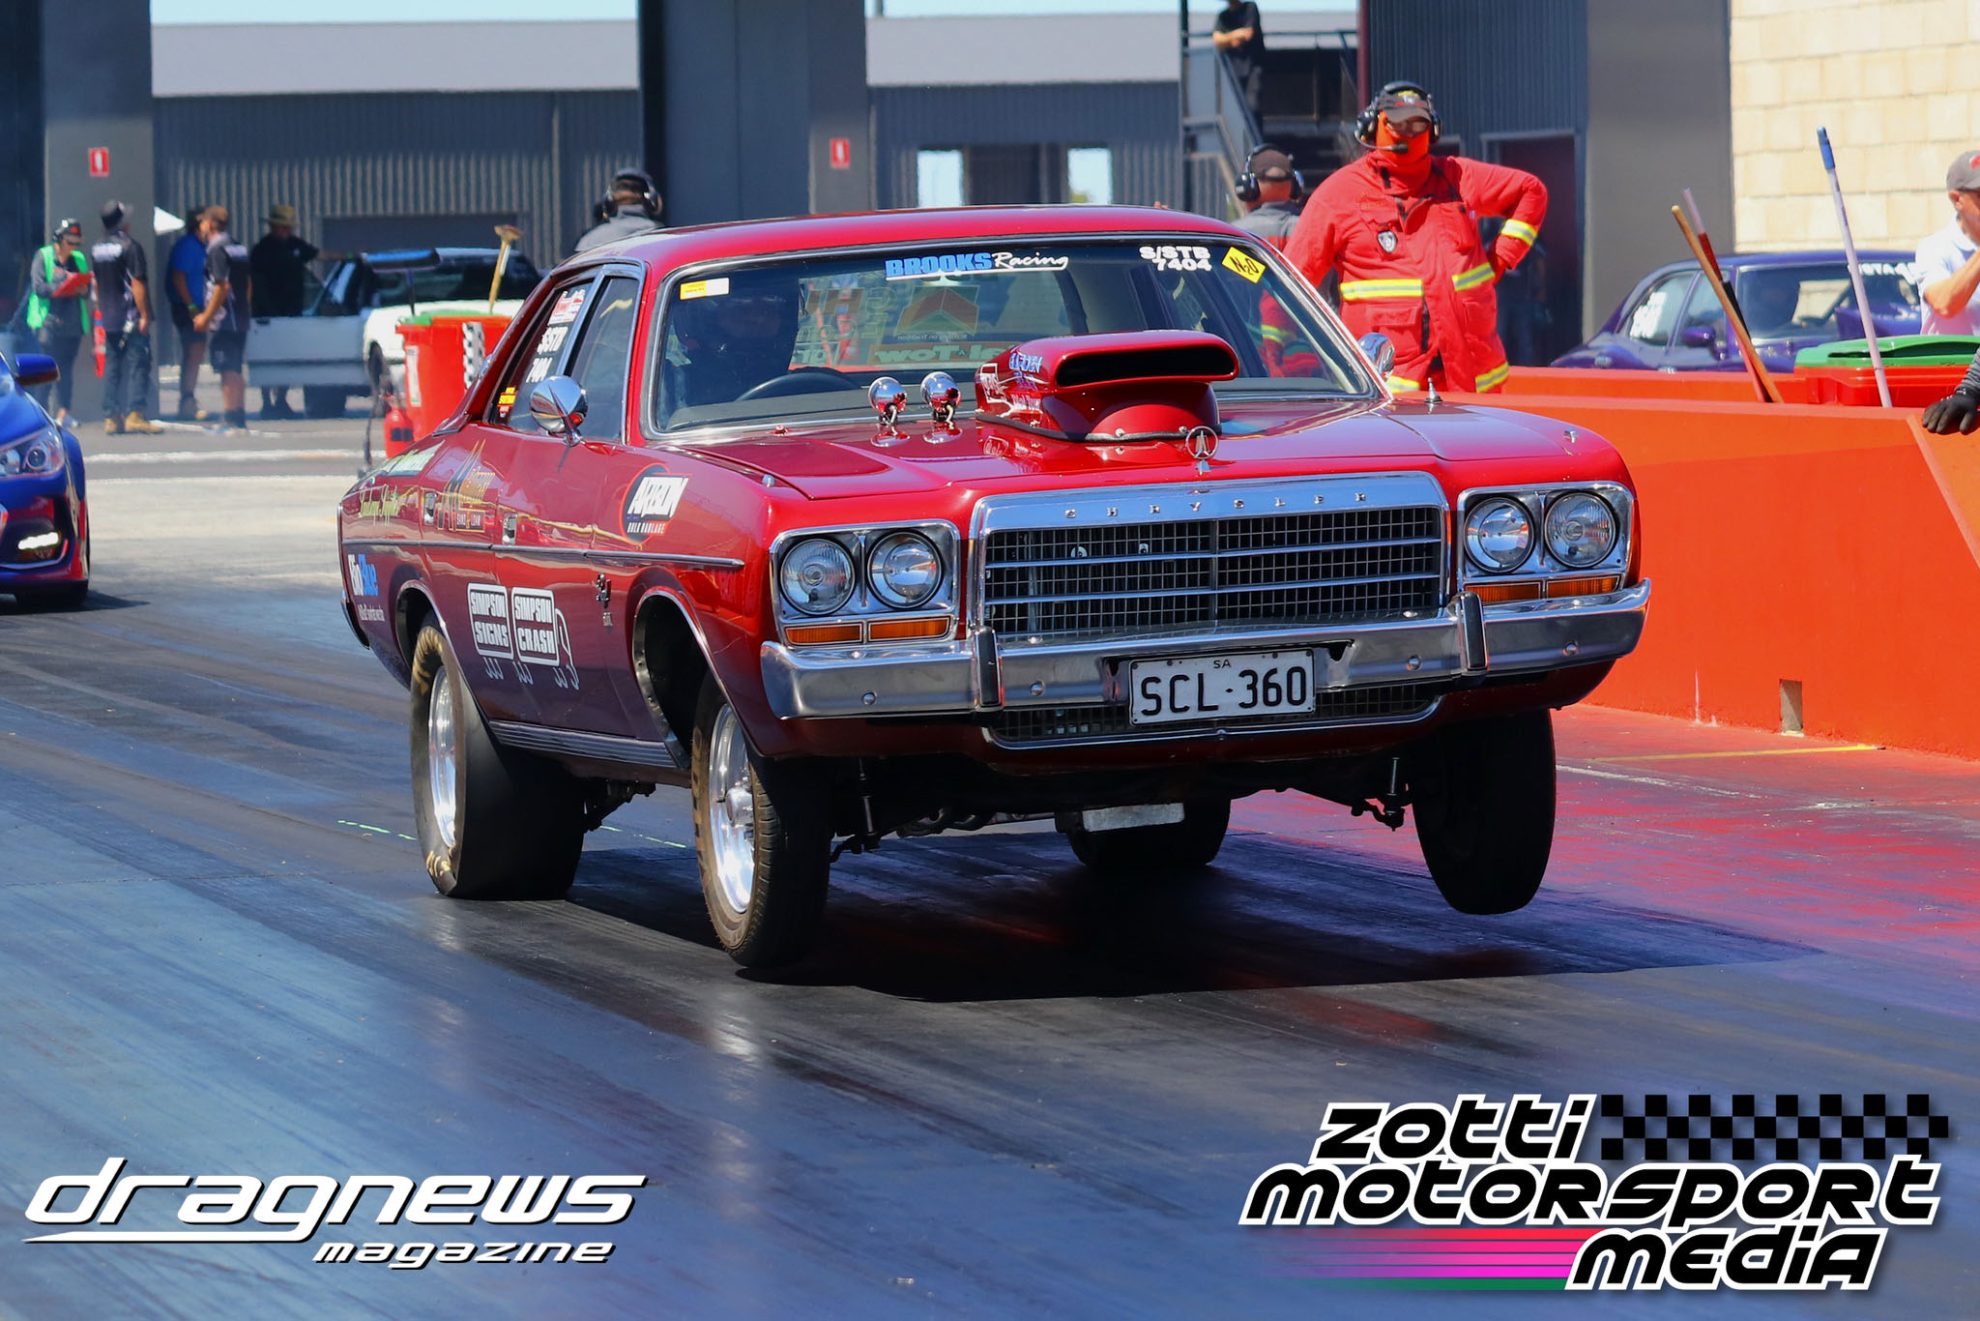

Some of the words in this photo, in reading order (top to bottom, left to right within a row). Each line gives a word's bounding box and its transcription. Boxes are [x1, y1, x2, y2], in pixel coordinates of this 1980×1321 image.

[885, 253, 992, 277] BROOKS
[991, 252, 1069, 270] Racing
[1139, 246, 1211, 261] S/STB
[1152, 258, 1212, 271] 7404
[1064, 491, 1367, 518] CHRYSLER
[470, 591, 506, 618] SIMPSON
[514, 596, 553, 623] SIMPSON
[474, 621, 509, 648] SIGNS
[517, 627, 556, 654] CRASH
[1213, 659, 1232, 669] SA
